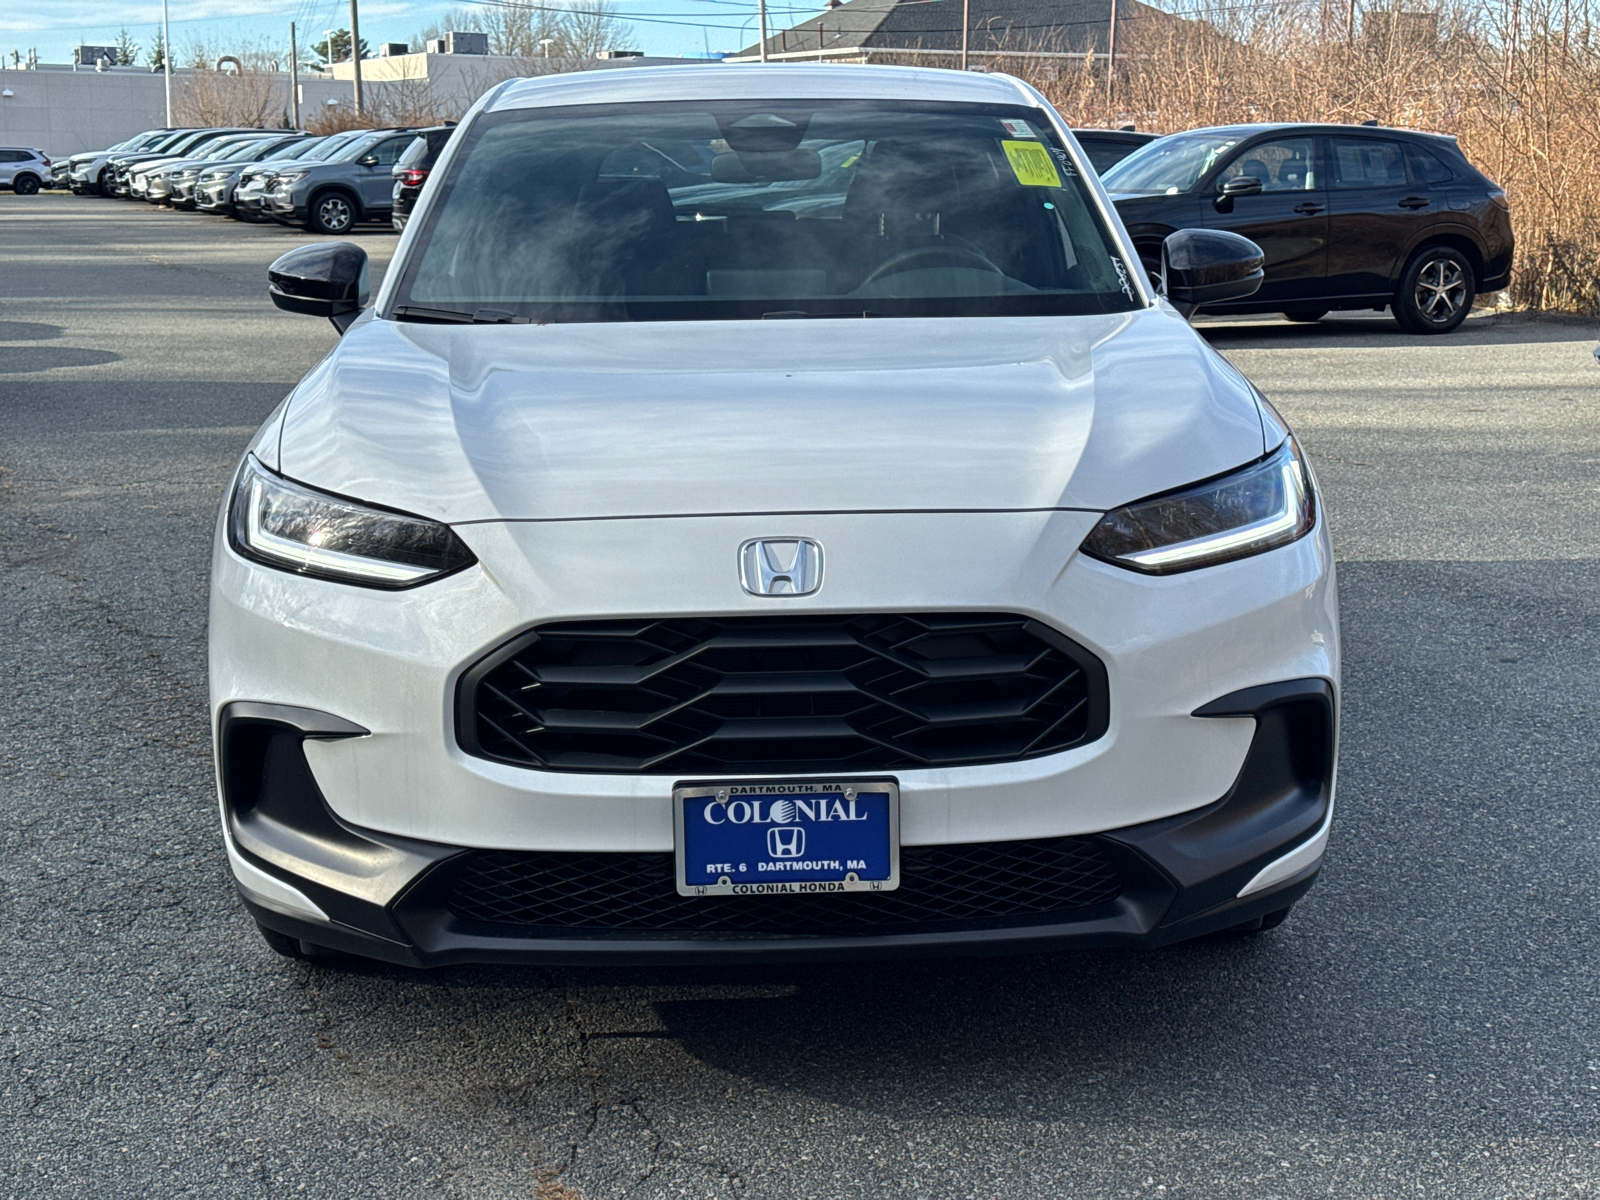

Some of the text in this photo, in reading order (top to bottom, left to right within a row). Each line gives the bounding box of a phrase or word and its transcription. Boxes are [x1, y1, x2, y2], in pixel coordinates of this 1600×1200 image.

[730, 784, 842, 794] DARTMOUTH, MA
[703, 798, 868, 825] COLONIAL
[706, 860, 867, 873] RTE. 6 DARTMOUTH, MA
[731, 883, 796, 895] COLONIAL
[799, 882, 845, 893] HONDA
